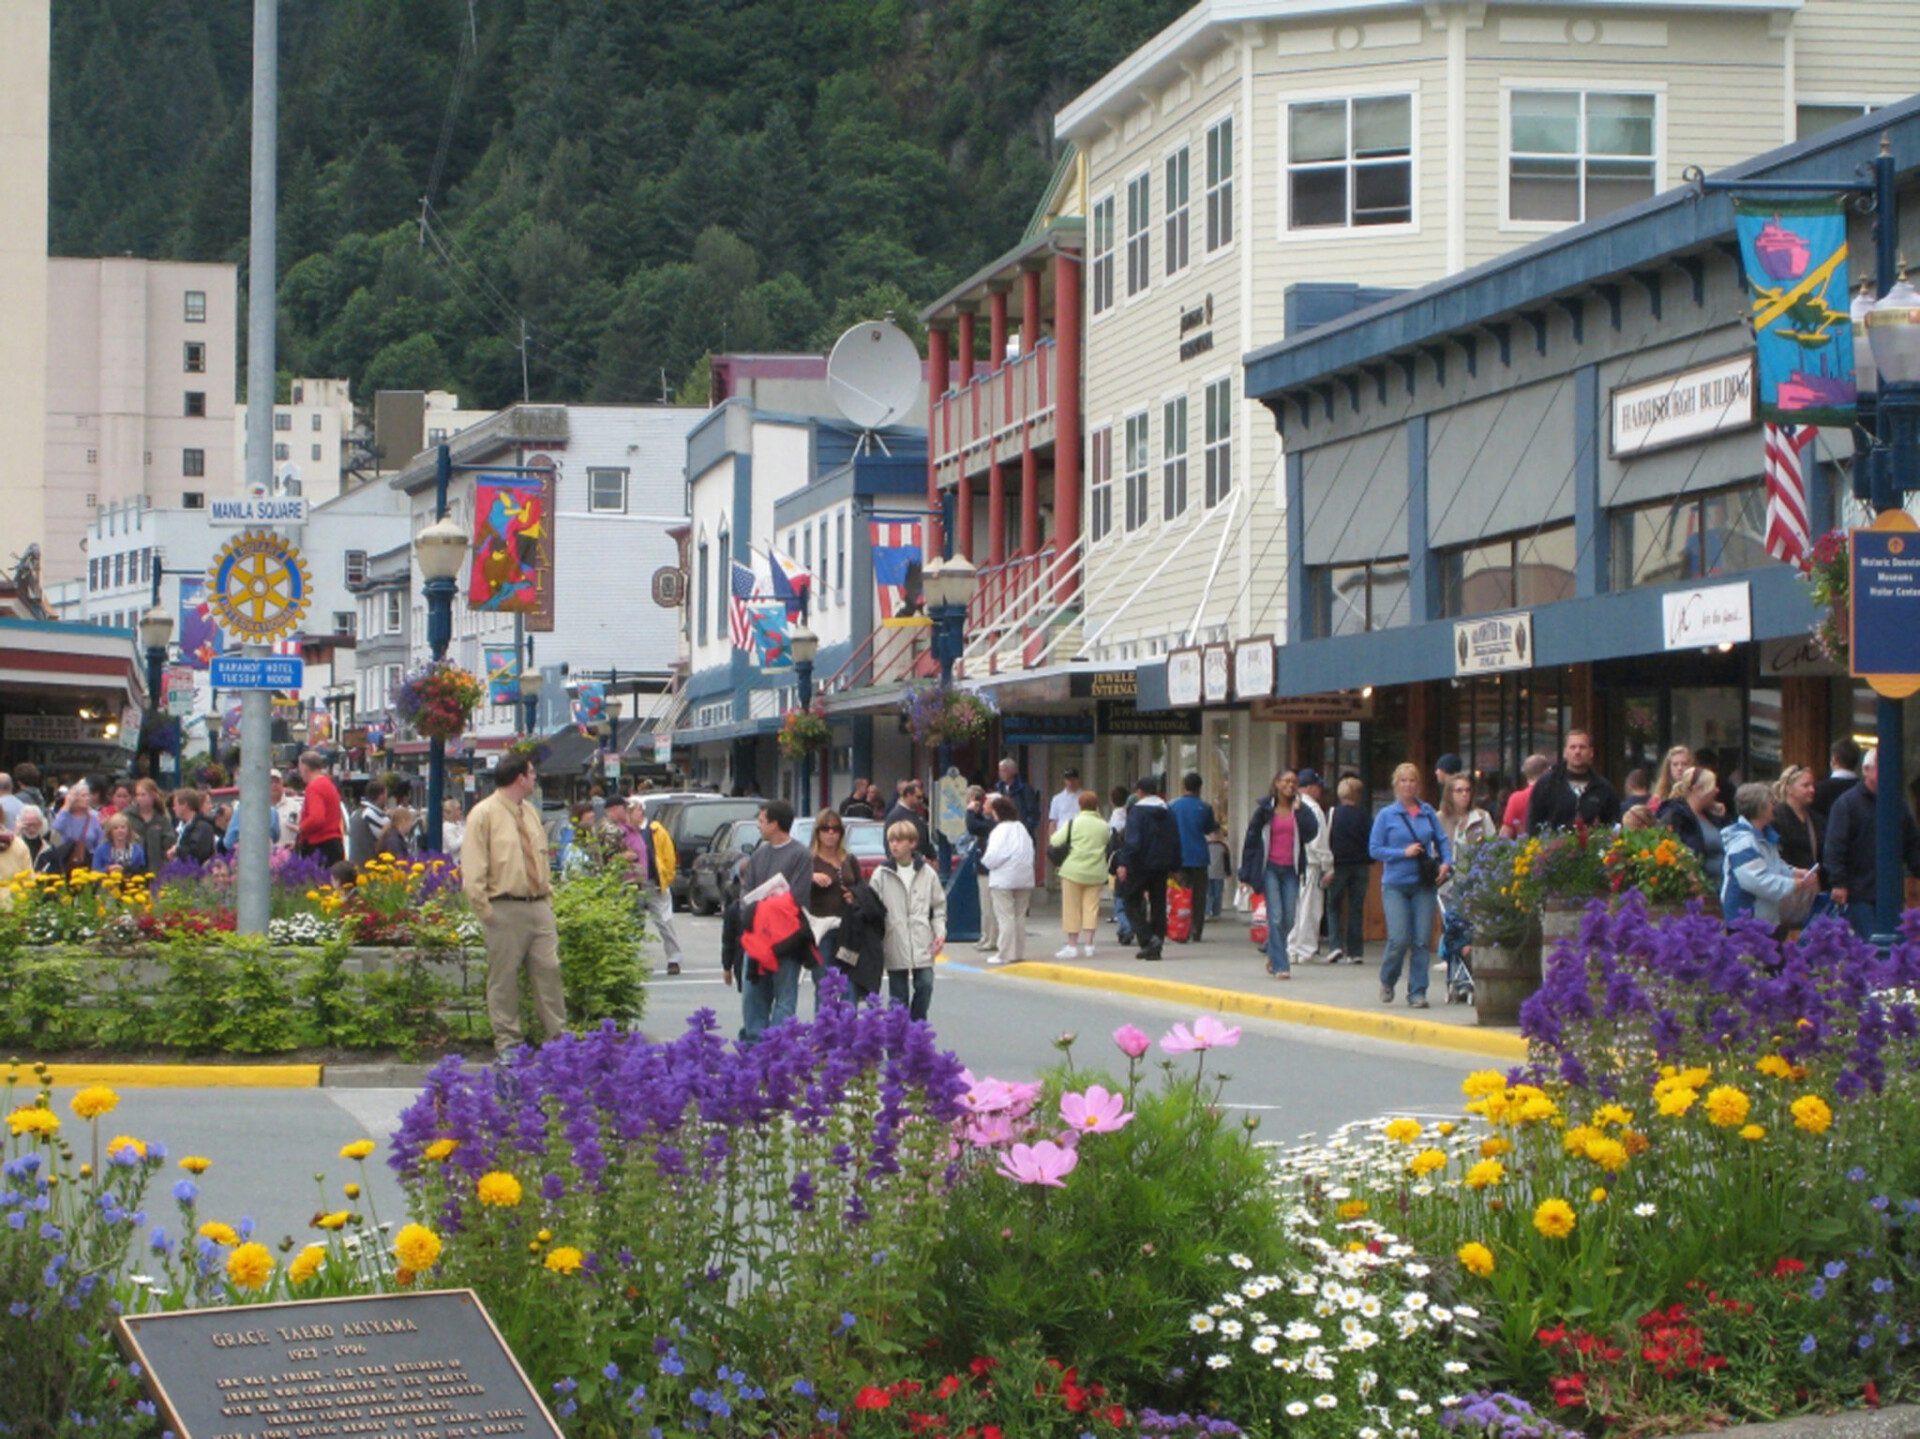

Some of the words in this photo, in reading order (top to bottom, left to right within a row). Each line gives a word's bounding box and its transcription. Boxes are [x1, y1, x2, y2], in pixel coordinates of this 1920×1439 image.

[1700, 373, 1750, 412] BUILDING
[212, 502, 253, 519] MANILA
[257, 502, 302, 519] SQUARE
[238, 540, 283, 556] ROTARY
[1861, 557, 1890, 567] Historic
[1878, 572, 1913, 581] Museums
[1870, 587, 1893, 596] Visitor
[218, 662, 261, 672] BARANOF
[266, 663, 292, 673] HOTEL
[222, 673, 261, 683] TUESDAY
[266, 675, 292, 684] NOON
[212, 1329, 270, 1348] GRACE
[276, 1324, 335, 1342] TAEKO
[343, 1319, 418, 1337] AKIYAMA
[334, 1343, 368, 1357] 1996
[216, 1378, 240, 1388] SHE
[243, 1376, 266, 1386] WAS
[270, 1375, 279, 1384] A
[358, 1365, 388, 1376] YEAR
[225, 1390, 269, 1402] JUNEAU
[273, 1387, 299, 1398] WHO
[382, 1378, 397, 1388] TO
[426, 1372, 469, 1384] BEAUTY
[220, 1404, 252, 1417] WITH
[256, 1403, 281, 1414] HER
[286, 1398, 333, 1411] SKILLED
[336, 1393, 396, 1406] GARDENING
[401, 1390, 424, 1400] AND
[428, 1384, 486, 1397] TALENTED
[341, 1420, 388, 1433] MEMORY
[482, 1422, 526, 1437] BEAUTY
